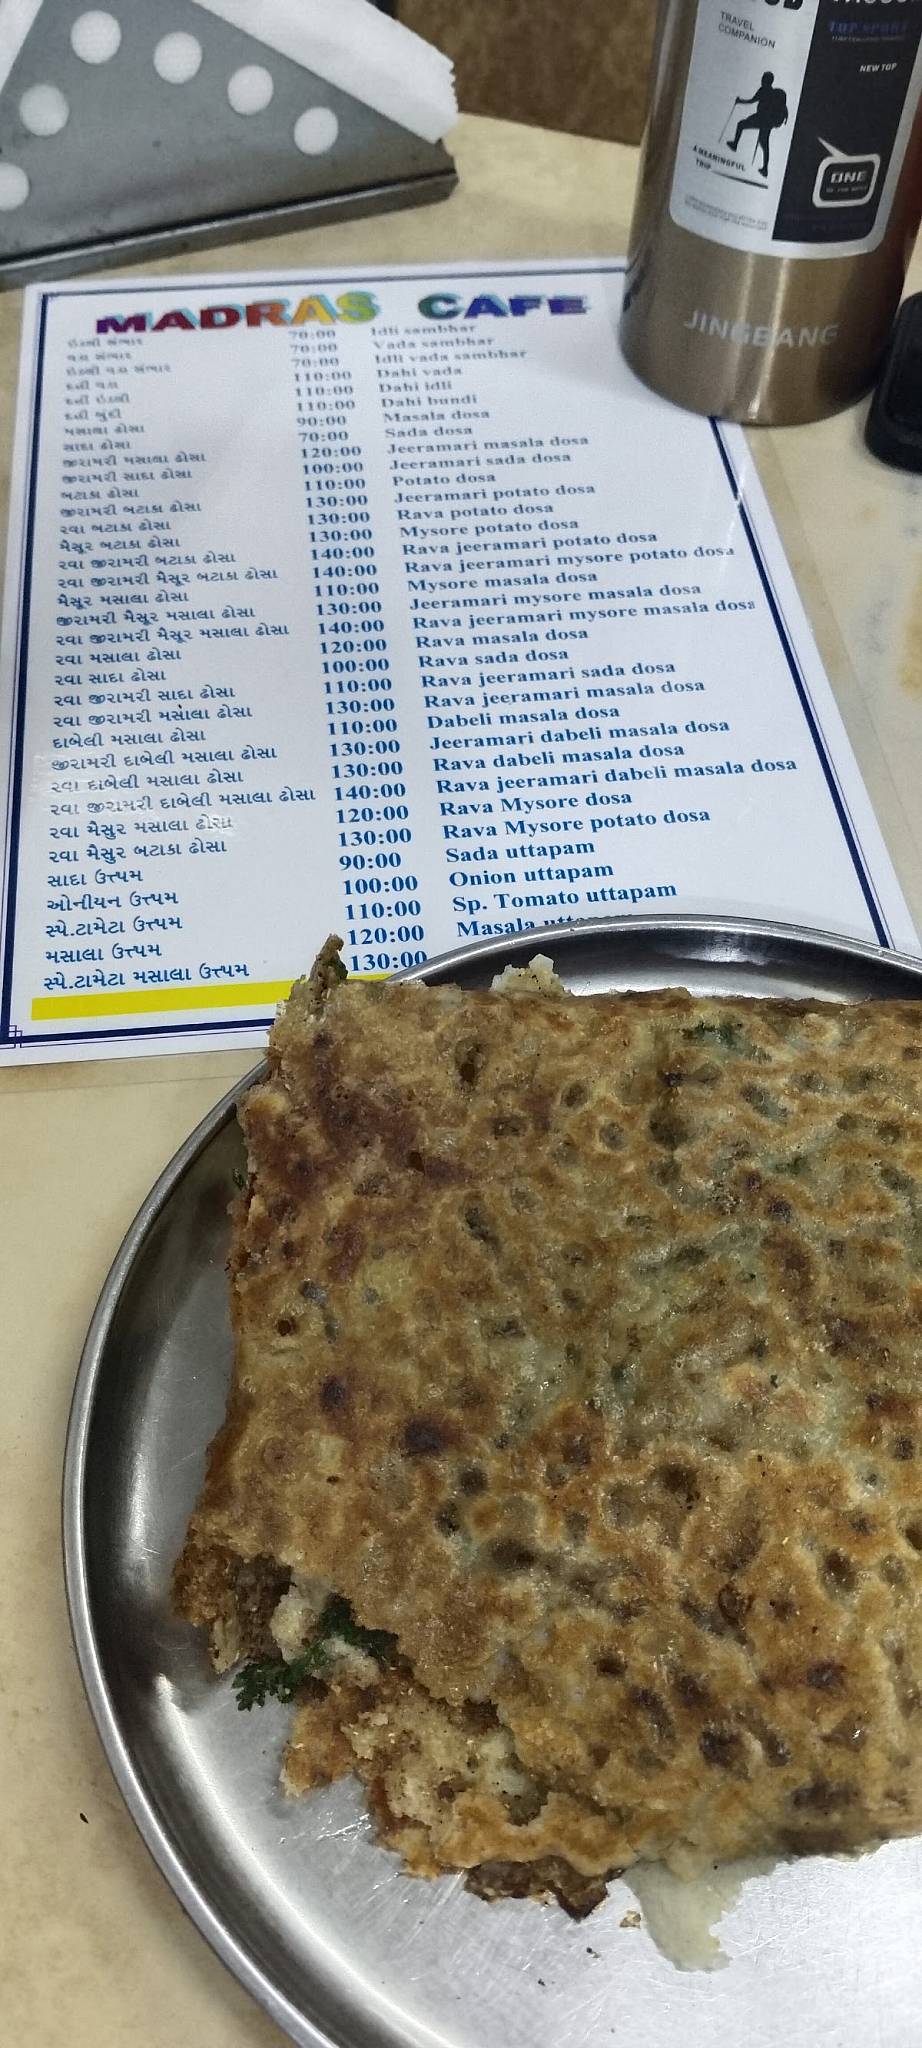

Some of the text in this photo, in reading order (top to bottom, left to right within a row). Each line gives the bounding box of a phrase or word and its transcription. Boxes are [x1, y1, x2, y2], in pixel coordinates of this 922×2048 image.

[720, 11, 754, 31] TRAVEL
[718, 24, 776, 49] COMPANION
[859, 62, 897, 73] NEW TOP
[831, 170, 868, 184] ONE
[97, 290, 588, 335] MADRAS CAFE
[288, 329, 336, 339] 70:00
[370, 323, 476, 336] Idli sambhar
[684, 309, 839, 348] JINGBANG
[290, 342, 338, 353] 70:00
[372, 336, 495, 350] Vada sambhar
[291, 357, 339, 367] 70:00
[374, 349, 527, 364] Idli vada sambhar
[294, 370, 352, 382] 110:00
[376, 365, 462, 378] Dahi vada
[295, 385, 354, 397] 110:00
[378, 380, 452, 393] Dahi idli
[297, 399, 355, 412] 110:00
[381, 394, 477, 408] Dahi bundi
[296, 415, 346, 426] 90:00
[383, 409, 490, 422] Masala dosa
[298, 430, 349, 442] 70:00
[384, 425, 473, 438] Sada dosa
[301, 446, 362, 458] 120:00
[387, 435, 588, 454] Jeeramari masala dosa
[303, 461, 363, 475] 100:00
[389, 452, 571, 470] Jeeramari sada dosa
[304, 478, 366, 491] 110:00
[392, 472, 496, 486] Potato dosa
[306, 495, 368, 508] 130:00
[394, 484, 595, 503] Jeeramari potato dosa
[308, 511, 370, 525] 130:00
[396, 503, 553, 521] Rava potato dosa
[310, 528, 372, 542] 130:00
[400, 519, 578, 539] Mysore potato dosa
[402, 532, 658, 555] Rava jeeramari potato dosa
[311, 546, 374, 560] 140:00
[404, 546, 734, 573] Rava jeeramari mysore potato dosa
[313, 564, 377, 578] 140:00
[315, 582, 379, 597] 110:00
[407, 571, 597, 591] Mysore masala dosa
[413, 599, 755, 629] Rava jeeramari mysore masala dosa
[319, 619, 384, 635] 140:00
[320, 638, 387, 654] 120:00
[415, 628, 588, 648] Rava masala dosa
[322, 658, 389, 674] 100:00
[418, 649, 569, 668] Rava sada dosa
[424, 680, 705, 708] Rava jeeramari masala dosa
[326, 698, 395, 714] 130:00
[427, 706, 620, 728] Dabeli masala dosa
[328, 718, 397, 735] 110:00
[429, 720, 729, 750] Jeeramari dabeli masala dosa
[330, 739, 400, 757] 130:00
[433, 744, 685, 771] Rava dabeli masala dosa
[332, 760, 403, 779] 130:00
[436, 759, 797, 794] Rava jeeramari dabeli masala dosa
[335, 782, 406, 800] 140:00
[439, 791, 632, 816] Rava Mysore dosa
[337, 805, 409, 823] 120:00
[443, 809, 710, 839] Rava Mysore potato dosa
[338, 827, 412, 847] 130:00
[339, 852, 401, 870] 90:00
[446, 842, 595, 863] Sada uttapam
[344, 875, 418, 895] 100:00
[449, 865, 613, 887] Onion uttapam
[452, 885, 677, 915] Sp. Tomato uttapam
[346, 899, 421, 920] 110:00
[347, 925, 424, 945] 120:00
[457, 918, 535, 937] Masala
[351, 950, 428, 971] 130:00
